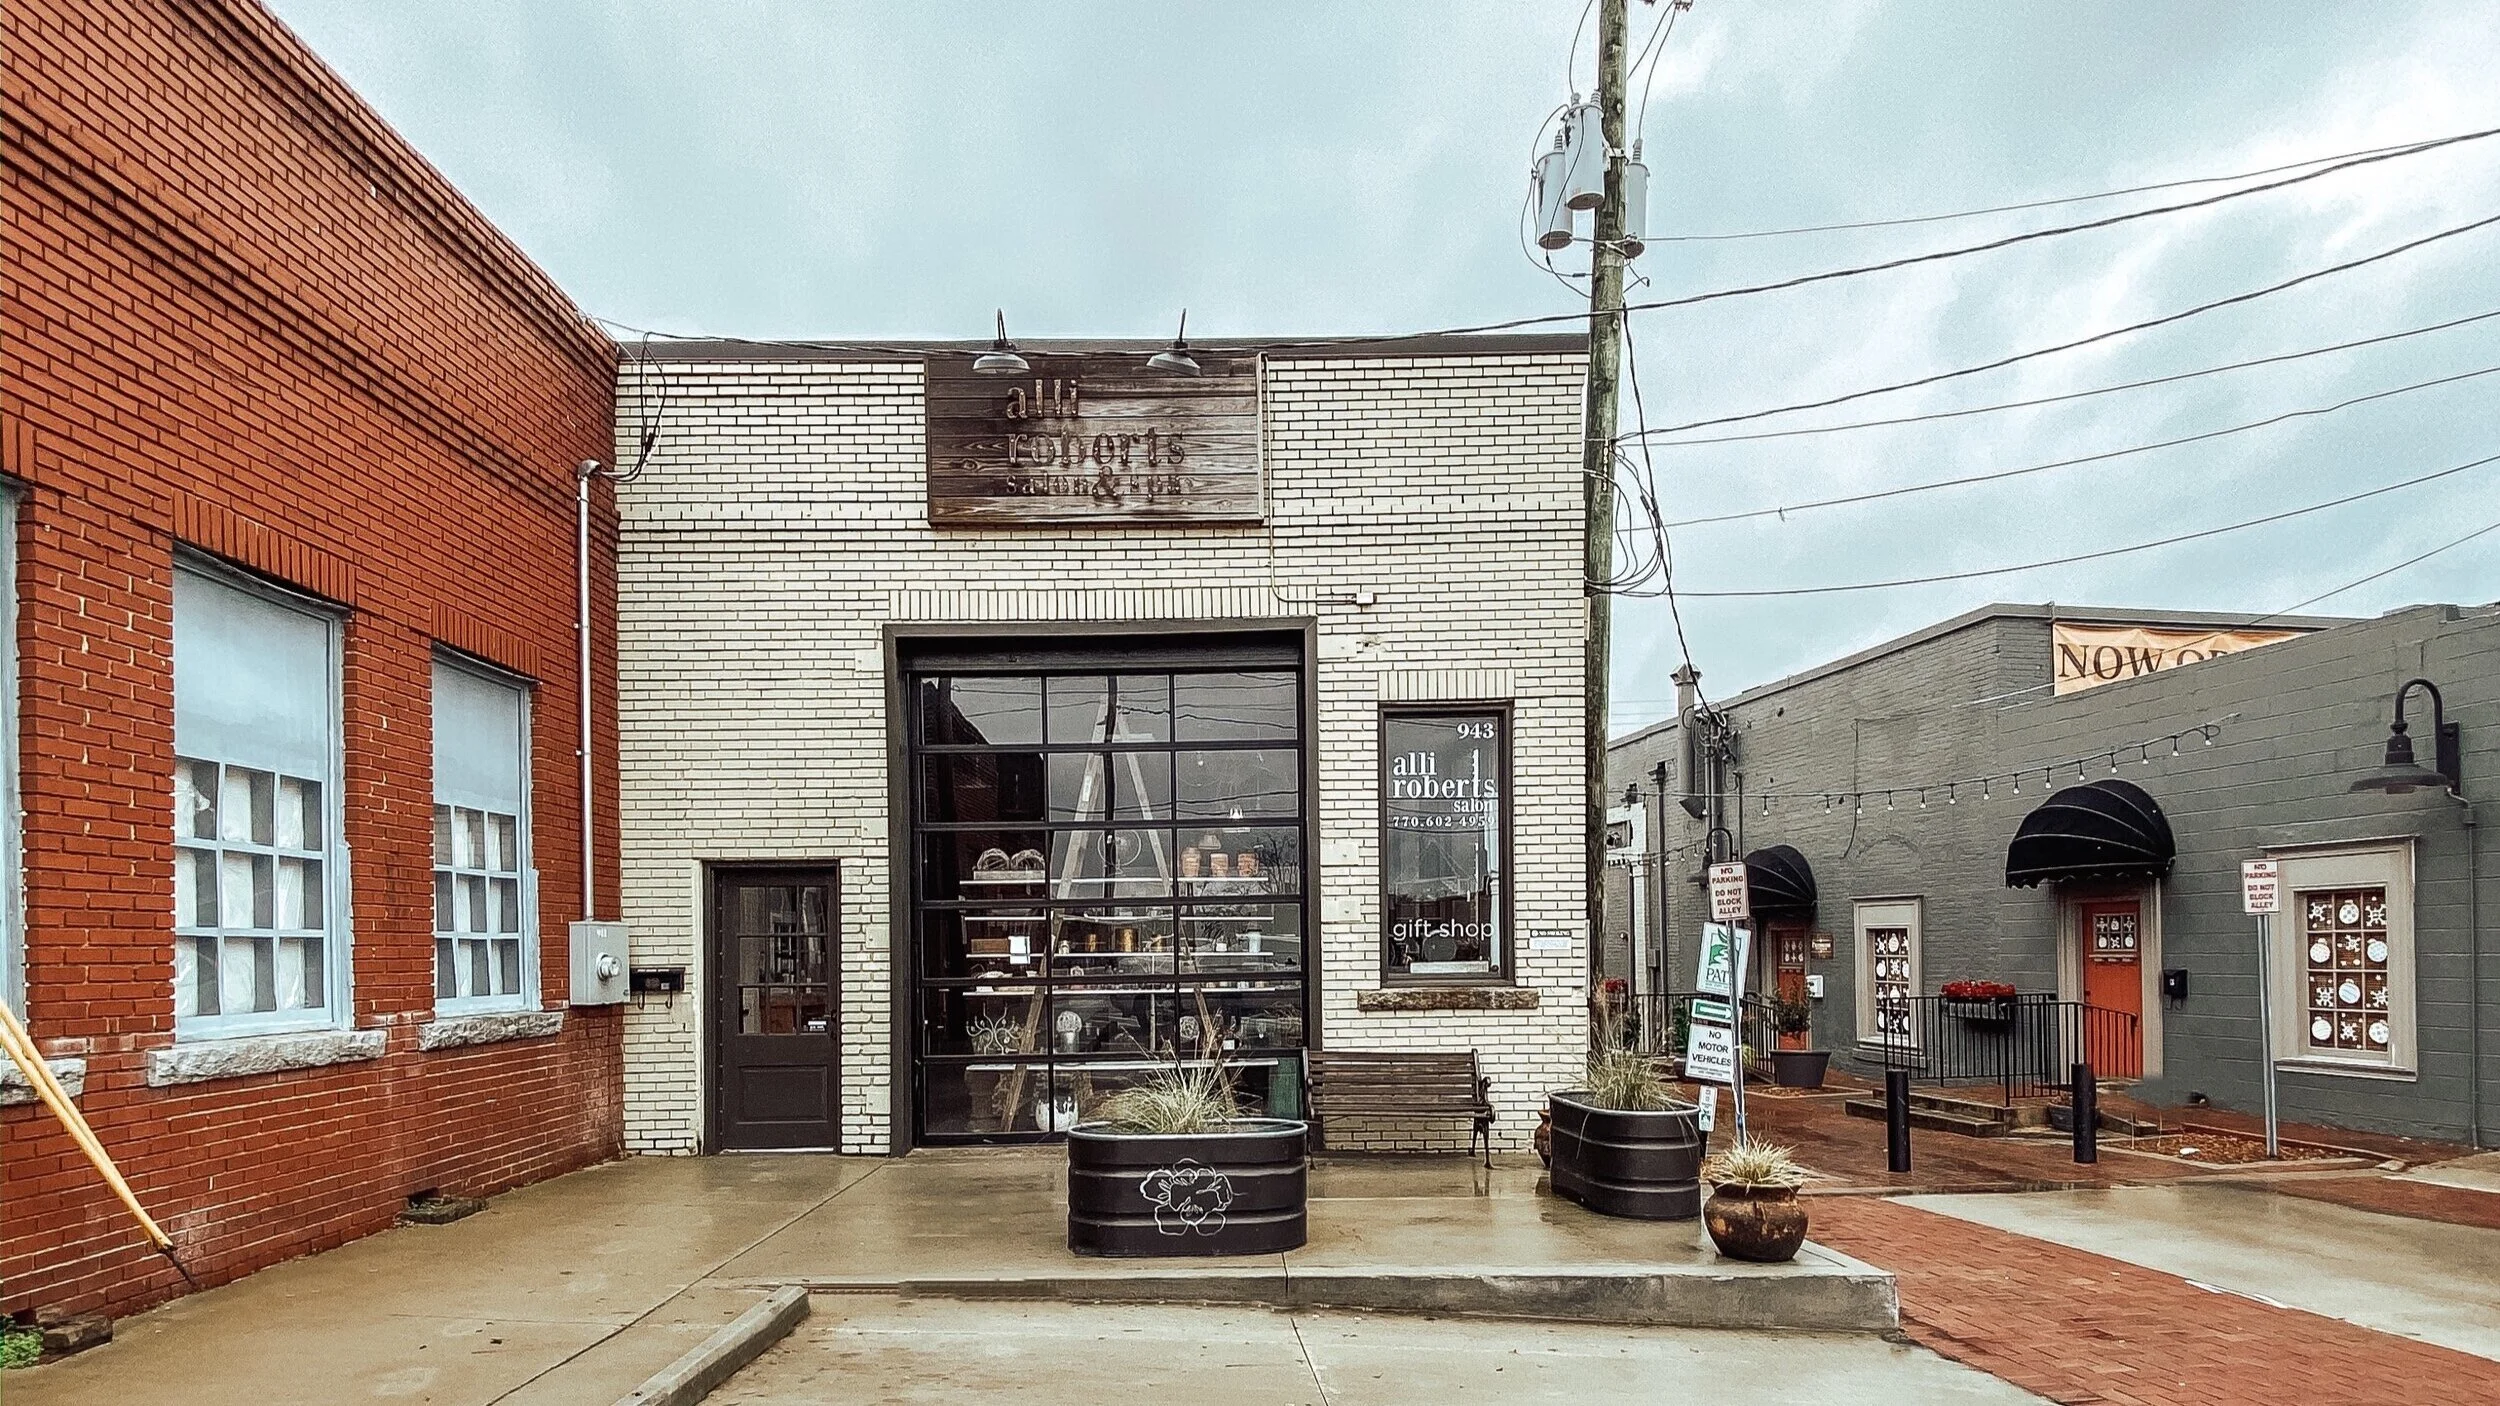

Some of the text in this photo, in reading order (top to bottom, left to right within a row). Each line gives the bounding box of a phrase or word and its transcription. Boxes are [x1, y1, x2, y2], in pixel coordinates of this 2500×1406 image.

[1007, 379, 1079, 419] alli
[1008, 427, 1185, 466] roberts
[2057, 643, 2165, 679] NOW
[1457, 722, 1495, 740] 943
[1393, 752, 1437, 776] alli
[1392, 775, 1497, 799] roberts
[1453, 798, 1493, 813] salon
[1727, 888, 1742, 896] NOT
[1717, 898, 1742, 906] BLOCK
[1719, 906, 1742, 915] ALLEY
[1393, 919, 1494, 941] gift shop
[1709, 1030, 1722, 1040] NO
[1698, 1042, 1729, 1054] MOTOR
[1692, 1053, 1732, 1067] VEHICLES
